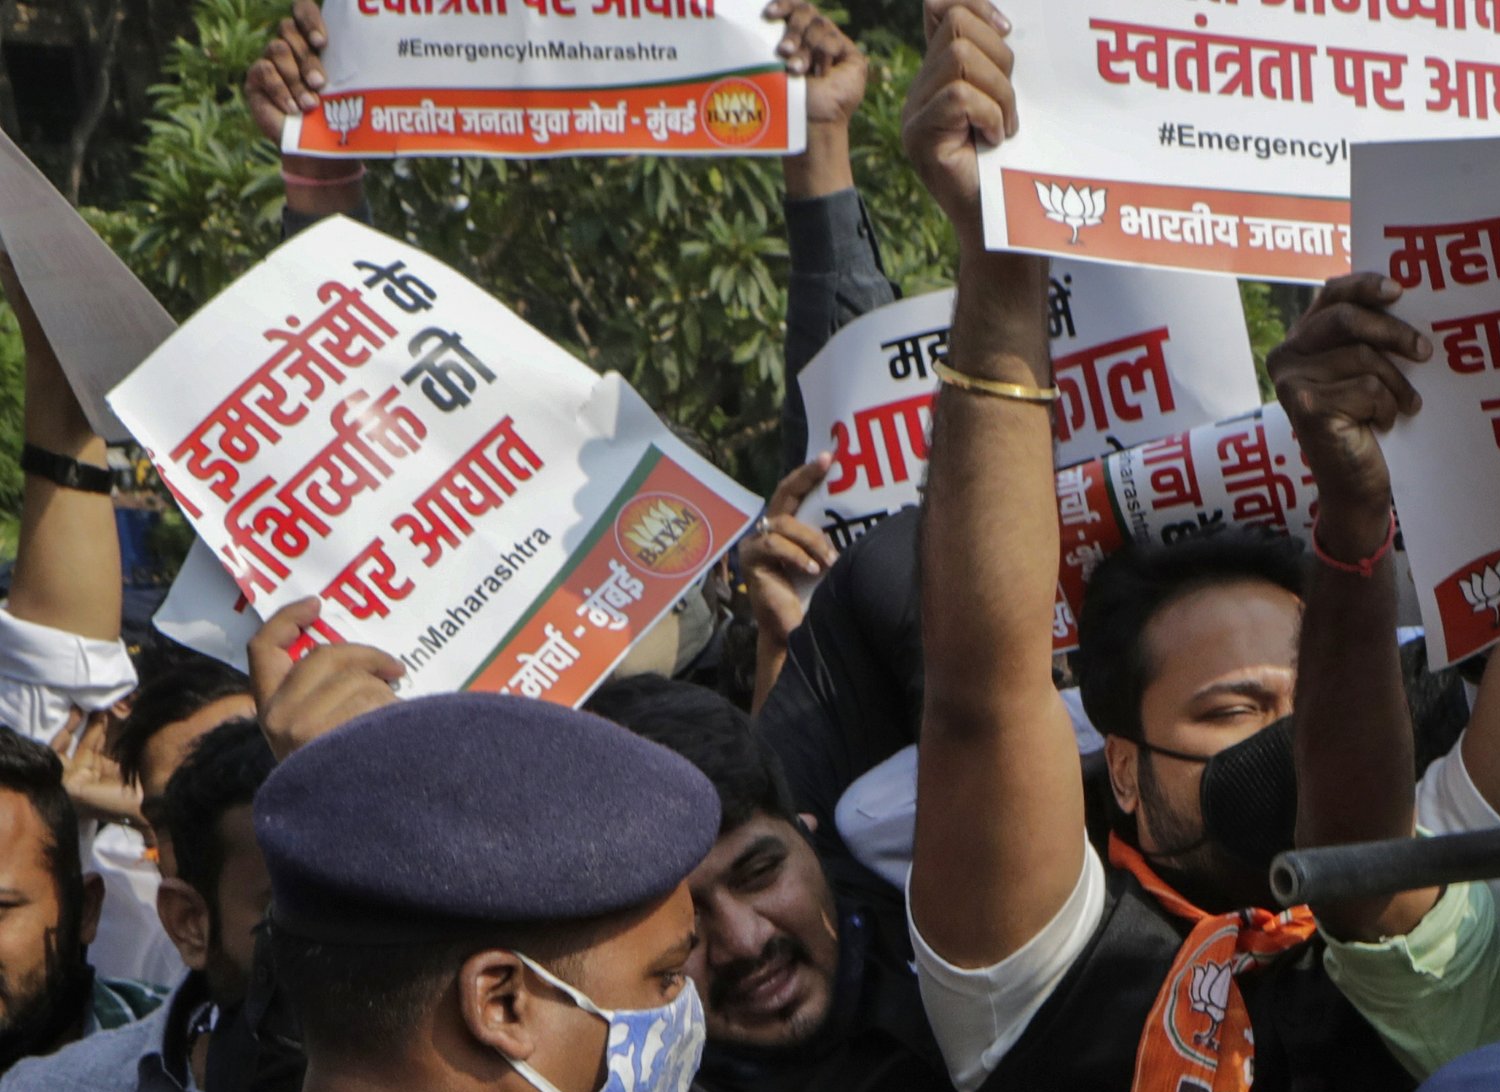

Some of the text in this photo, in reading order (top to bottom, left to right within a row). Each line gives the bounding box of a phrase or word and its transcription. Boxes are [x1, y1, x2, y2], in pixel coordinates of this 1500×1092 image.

[397, 38, 678, 63] #EmergencyInMaharashtra
[1090, 14, 1317, 104] स्वतंत्रता
[1327, 47, 1408, 112] पर
[371, 99, 455, 135] भारतीय
[458, 106, 524, 136] जनता
[527, 106, 570, 143] युवा
[572, 100, 626, 135] मोर्चा
[645, 100, 697, 143] मुंबई
[1157, 121, 1349, 165] #EmergencyI
[1119, 201, 1239, 248] भारतीय
[1243, 215, 1335, 257] जनता
[168, 281, 399, 503] इमरजेंसी
[352, 259, 437, 314] के
[400, 326, 498, 413] की
[319, 415, 545, 620] पर आघात
[638, 507, 697, 567] BJYM
[508, 622, 581, 700] मोर्चा
[576, 557, 645, 632] मुंबई
